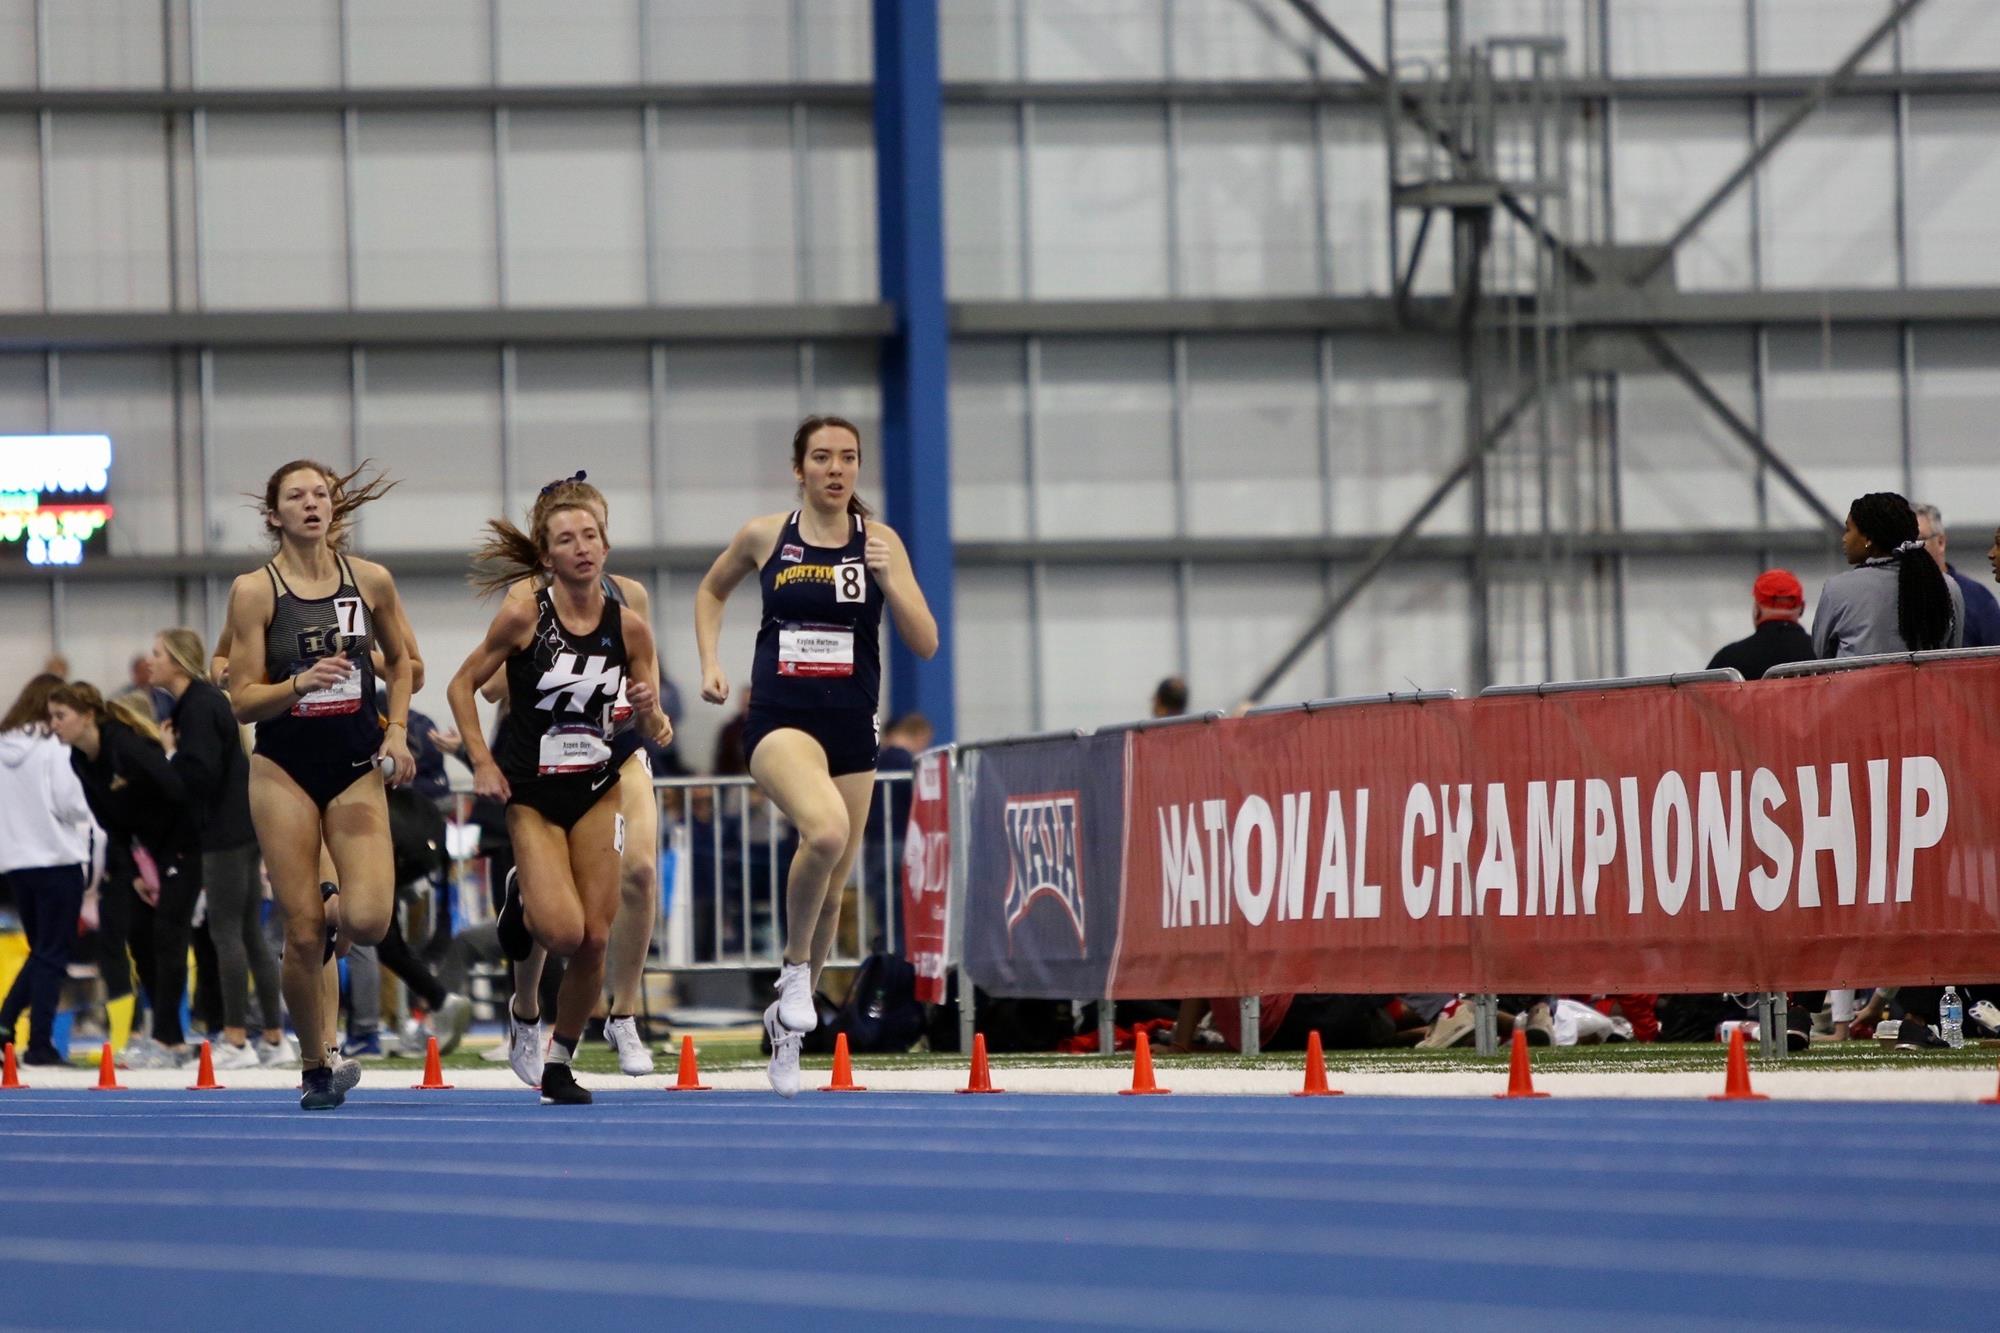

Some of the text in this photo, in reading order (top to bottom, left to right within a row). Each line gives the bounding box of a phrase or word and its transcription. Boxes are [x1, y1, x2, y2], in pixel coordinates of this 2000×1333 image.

[842, 567, 861, 599] 8
[338, 601, 357, 633] 7
[1158, 755, 1948, 928] NATIONAL CHAMPIONSHIP
